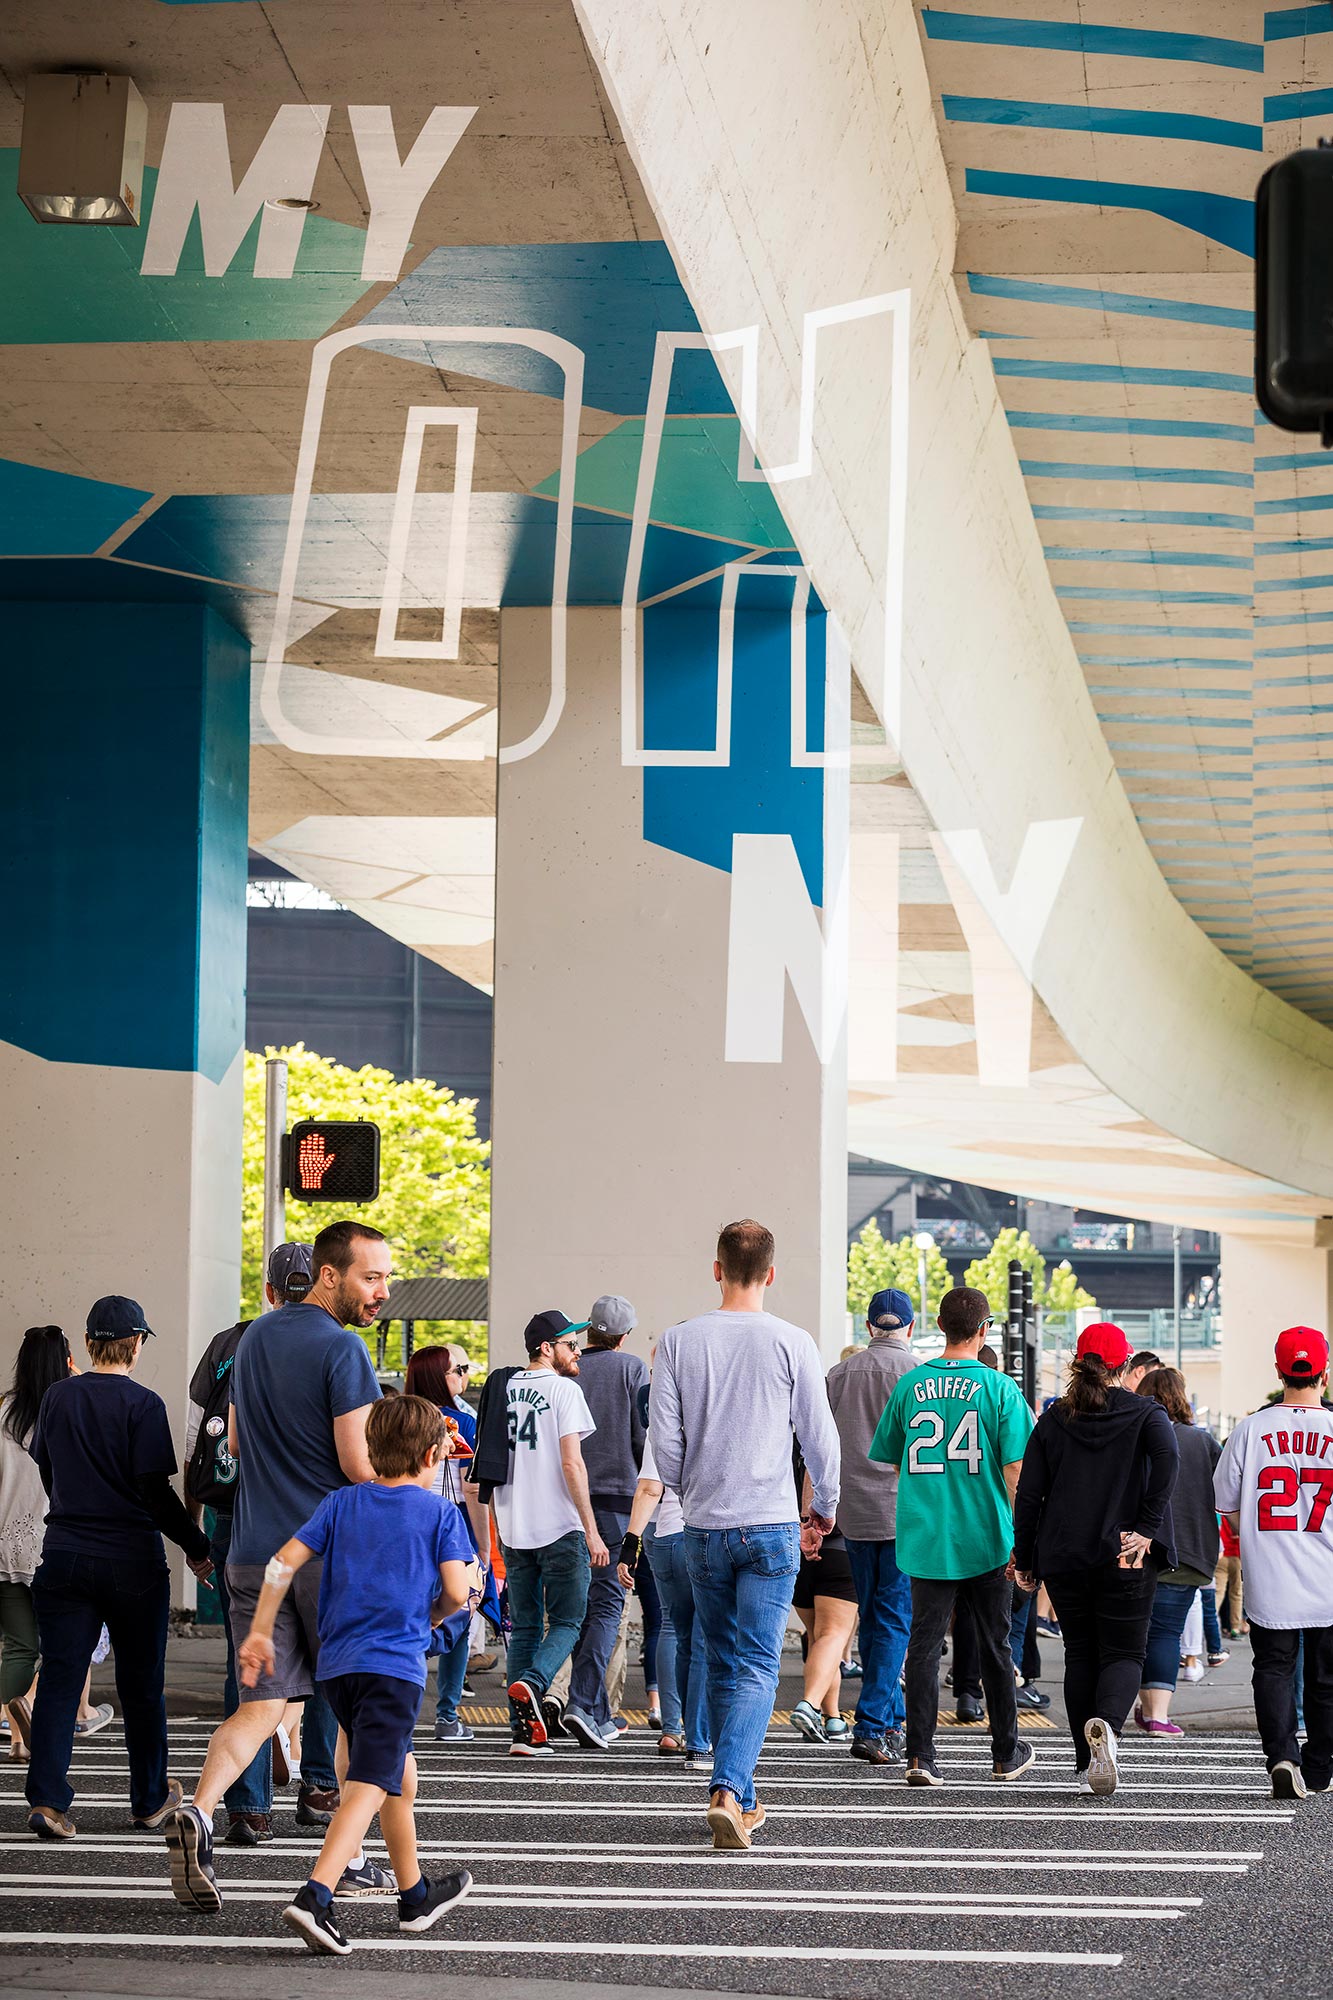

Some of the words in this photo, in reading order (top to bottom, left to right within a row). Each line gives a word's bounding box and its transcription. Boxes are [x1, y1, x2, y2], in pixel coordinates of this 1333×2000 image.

[139, 102, 480, 283] MY
[260, 287, 911, 767] OH
[724, 816, 1085, 1088] MY
[913, 1376, 983, 1403] GRIFFEY
[908, 1410, 983, 1475] 24
[1261, 1430, 1333, 1459] TROUT
[1257, 1466, 1333, 1533] 27
